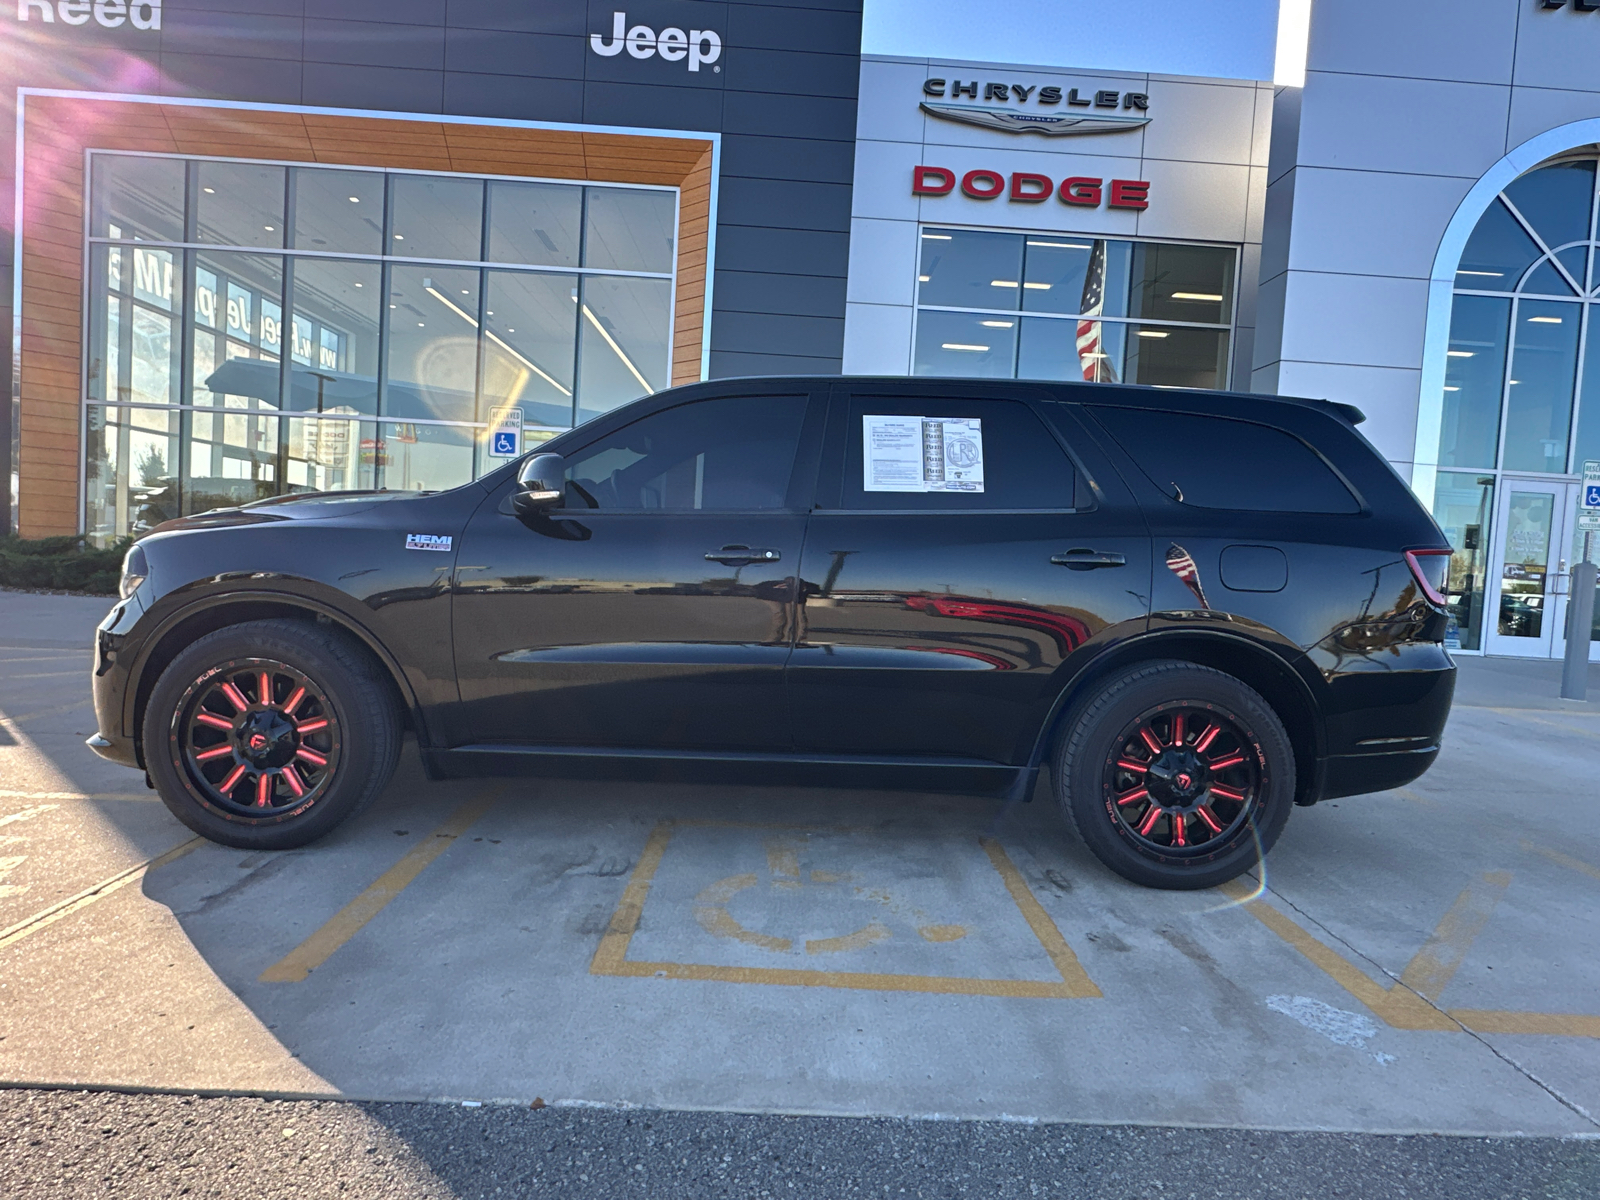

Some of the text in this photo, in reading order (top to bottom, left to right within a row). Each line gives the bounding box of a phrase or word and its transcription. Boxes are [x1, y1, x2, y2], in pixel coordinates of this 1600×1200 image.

[590, 11, 722, 72] Jeep
[923, 78, 1150, 110] CHRYSLER
[912, 165, 1151, 211] DODGE
[406, 533, 453, 544] HEMI
[1253, 742, 1267, 770] FUEL
